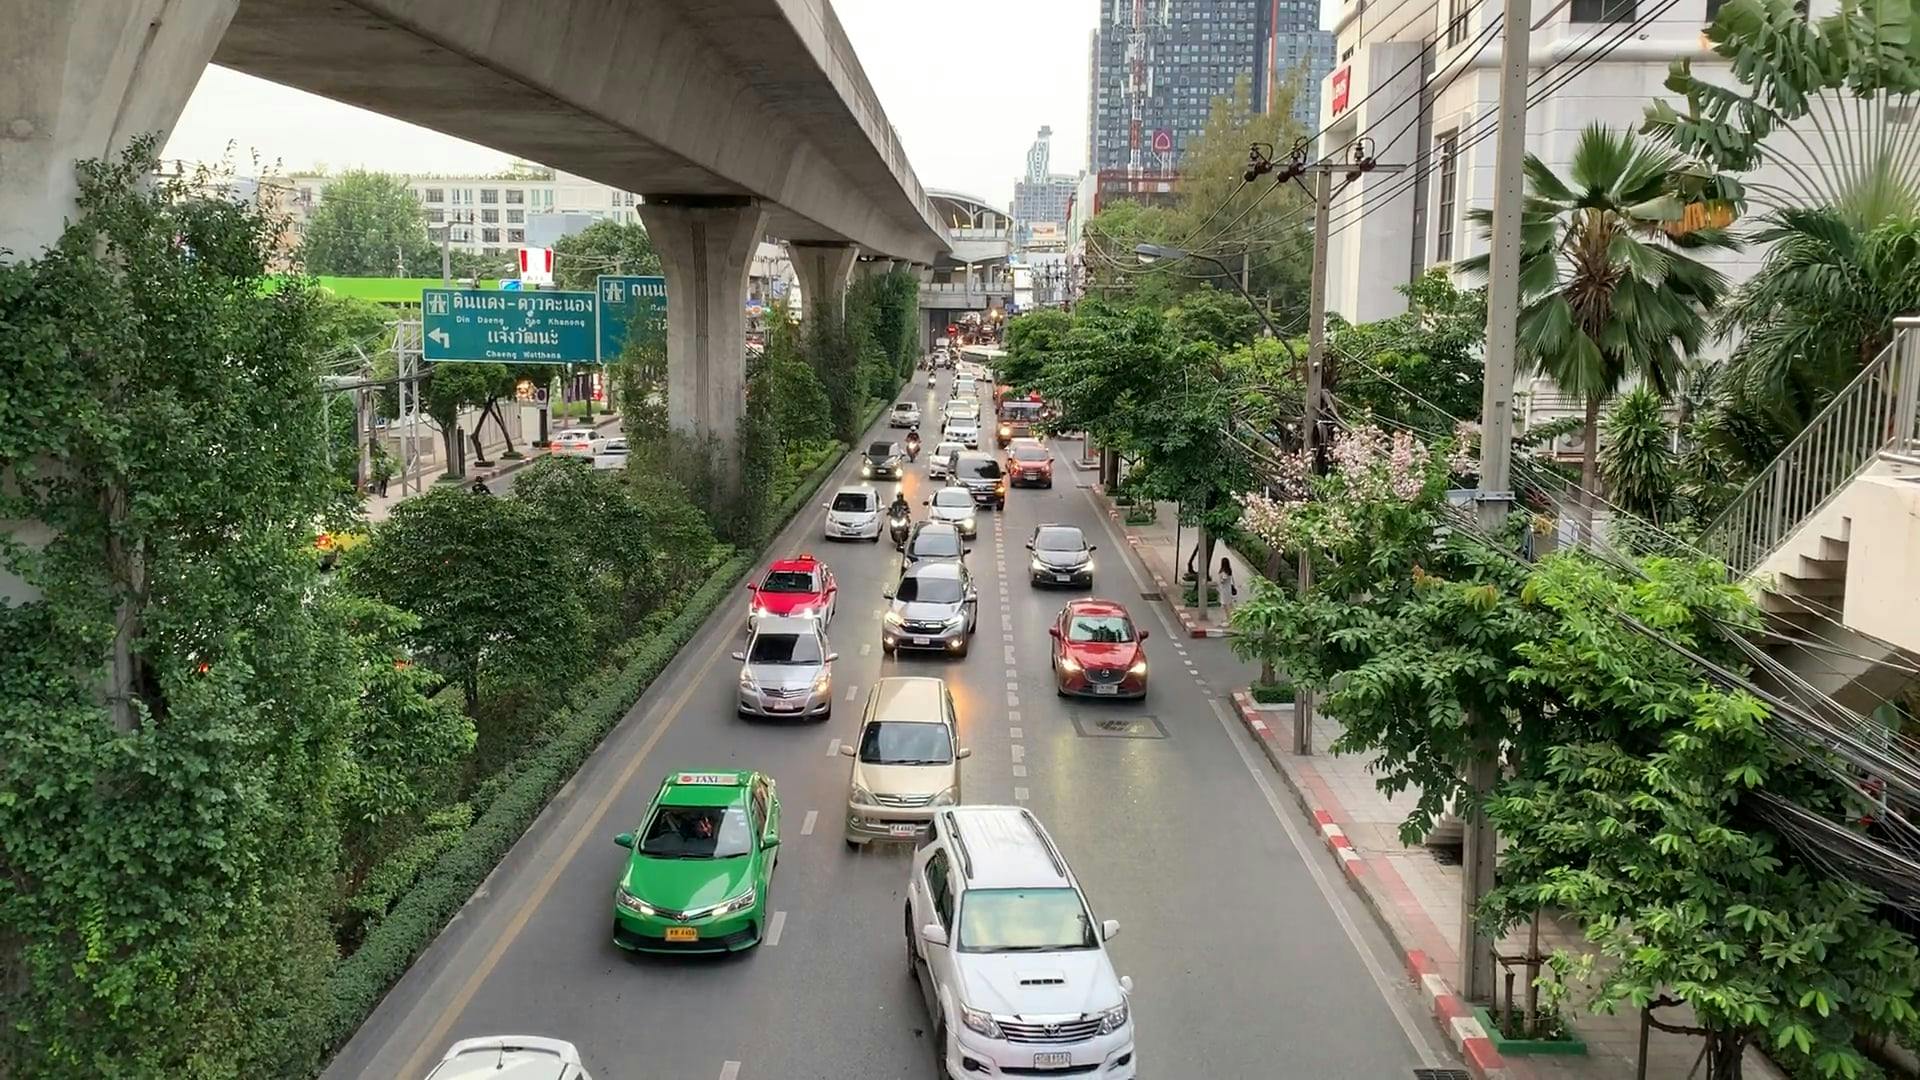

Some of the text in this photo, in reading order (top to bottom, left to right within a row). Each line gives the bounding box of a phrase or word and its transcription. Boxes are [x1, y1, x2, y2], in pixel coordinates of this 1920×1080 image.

[478, 317, 504, 326] Daeng
[548, 318, 585, 327] Khanong
[486, 350, 517, 360] Chaeng
[694, 775, 718, 783] TAXI
